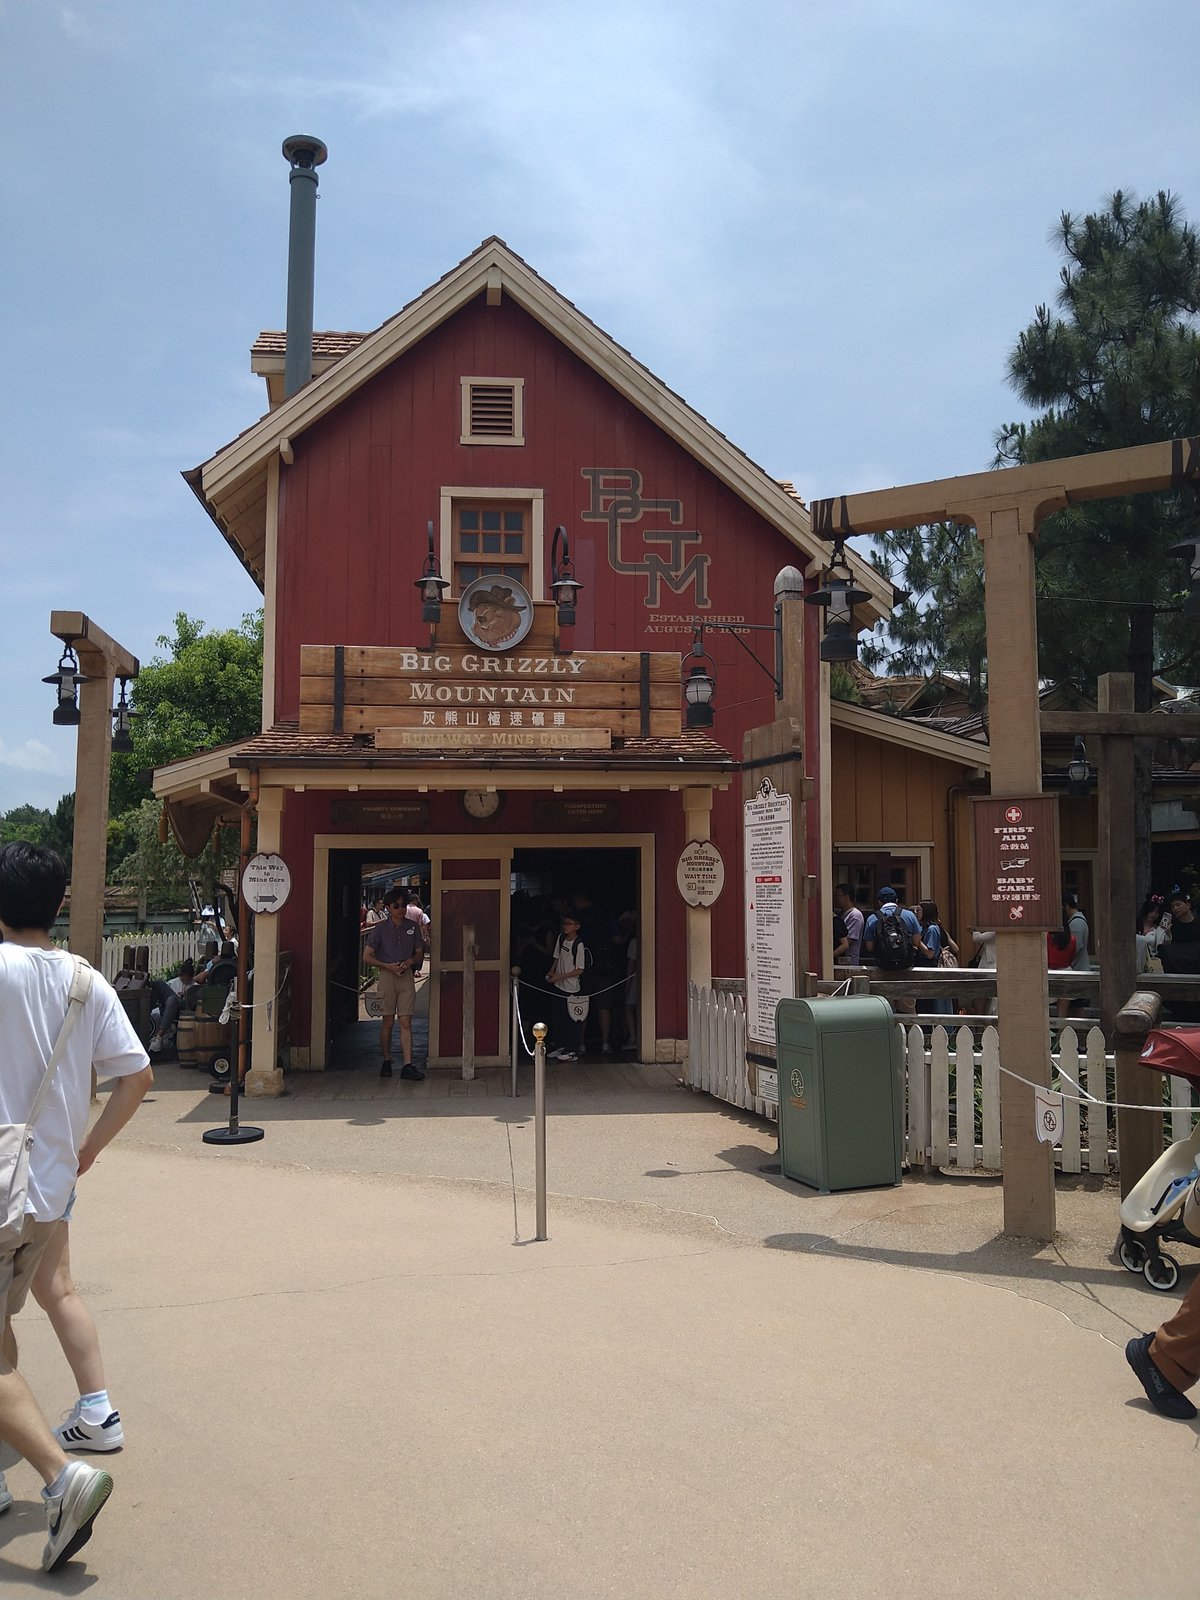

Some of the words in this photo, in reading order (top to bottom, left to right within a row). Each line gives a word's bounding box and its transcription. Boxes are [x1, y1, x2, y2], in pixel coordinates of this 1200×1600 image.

[400, 653, 452, 671] BIG
[461, 654, 586, 674] GRIZZLY
[409, 683, 576, 703] MOUNTAIN
[422, 711, 566, 726] 灰熊山極速礦車
[402, 733, 487, 745] RUNAWAY
[492, 732, 535, 745] MINE
[993, 826, 1035, 834] FIRST
[1148, 1367, 1164, 1394] HOKA
